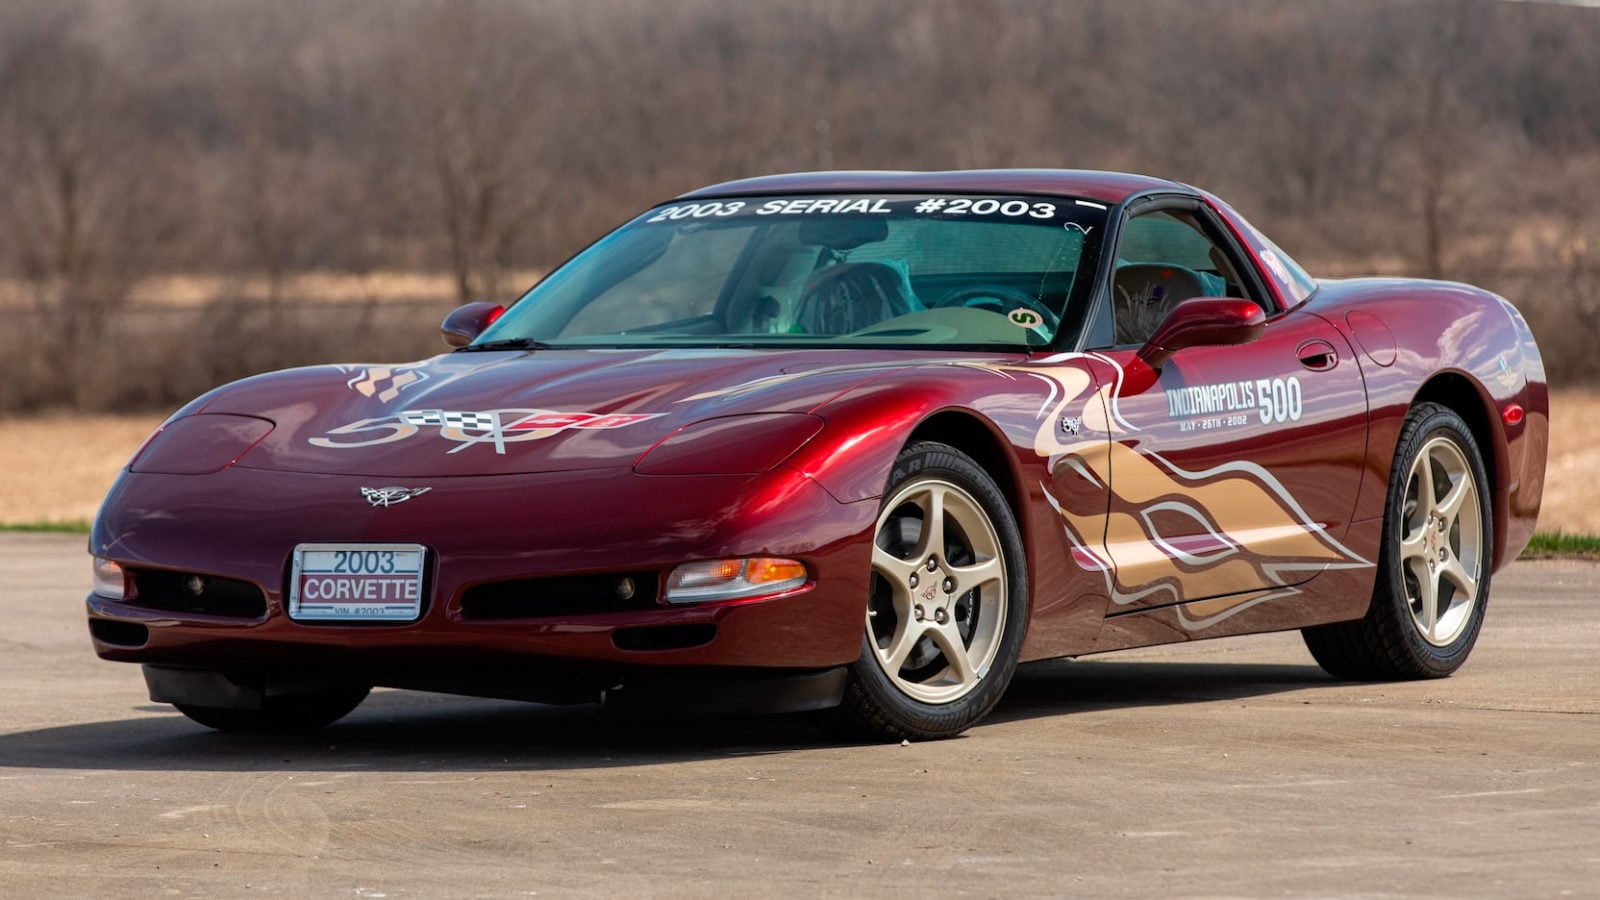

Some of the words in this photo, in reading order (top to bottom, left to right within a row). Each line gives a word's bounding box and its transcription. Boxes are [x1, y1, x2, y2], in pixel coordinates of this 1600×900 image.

[647, 202, 745, 222] 2003
[756, 199, 892, 215] SERIAL
[914, 199, 1056, 218] #2003
[1166, 381, 1254, 416] INDIANAPOLIS
[1256, 376, 1303, 424] 500
[1180, 420, 1196, 431] MAY
[1227, 416, 1247, 426] 2002
[333, 551, 395, 574] 2003
[304, 579, 418, 600] CORVETTE
